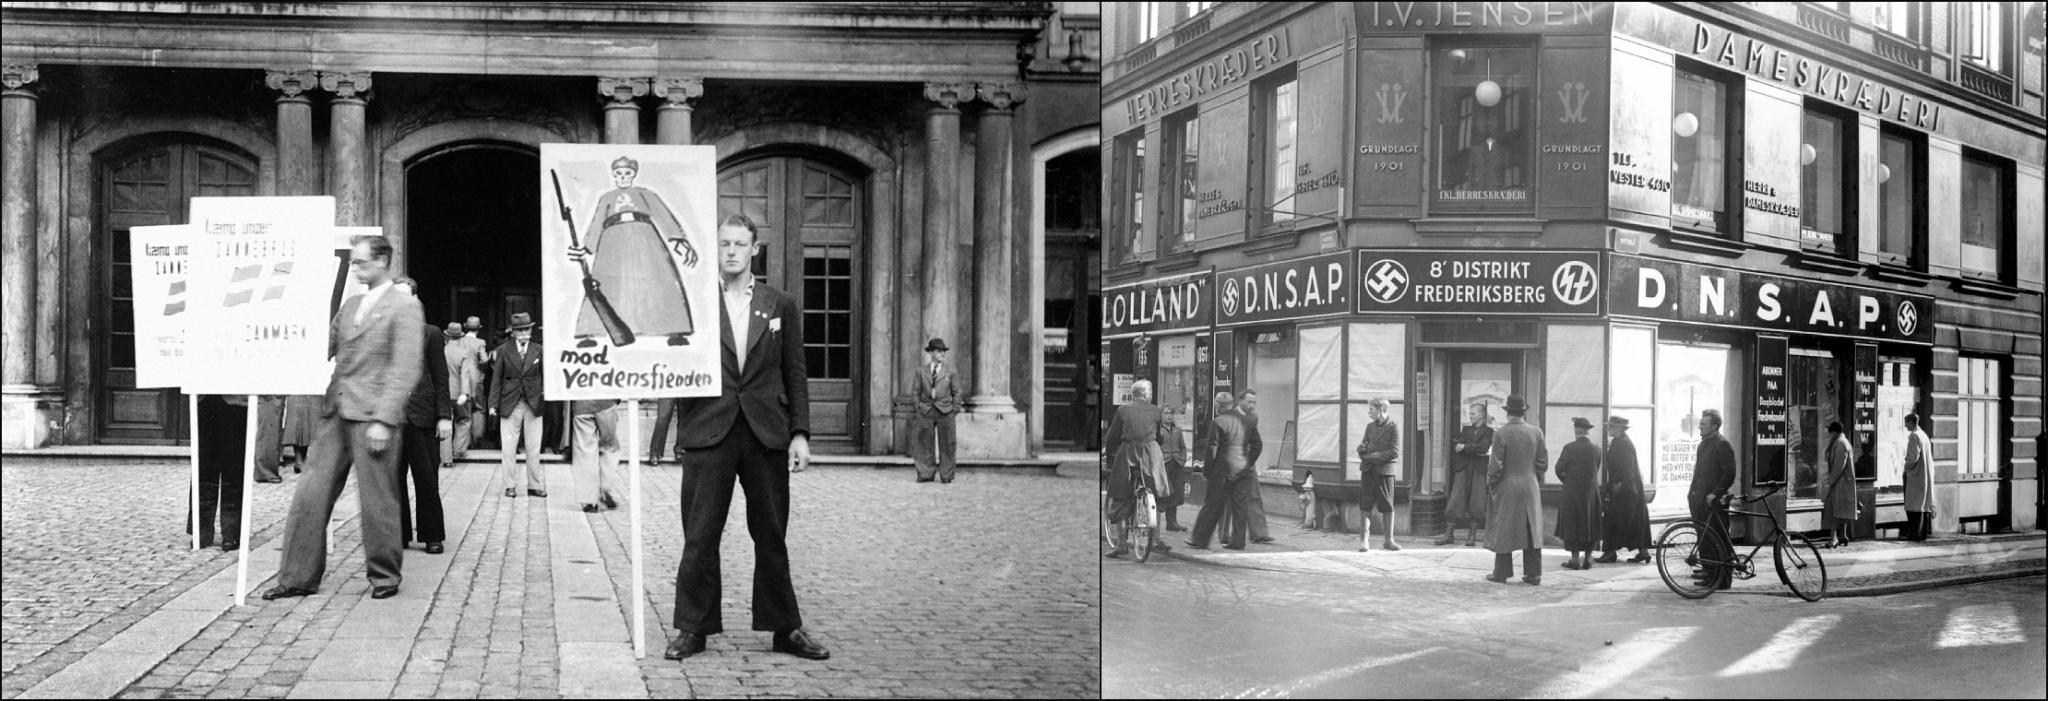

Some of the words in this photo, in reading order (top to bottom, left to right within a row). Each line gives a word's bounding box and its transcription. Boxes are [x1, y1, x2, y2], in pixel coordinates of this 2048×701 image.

[1126, 26, 1292, 125] HERRESKRÆDERI
[1694, 22, 1942, 132] DAMESKRÆDERI
[1360, 144, 1419, 154] GRUNDLAGT
[1542, 144, 1602, 154] GRUNDLAGT
[1374, 161, 1404, 171] 1901
[1557, 161, 1587, 171] 1901
[1452, 261, 1531, 279] DISTRIKT
[1415, 285, 1546, 304] FREDERIKSBERG
[560, 345, 609, 365] mod
[1767, 380, 1778, 390] PAA
